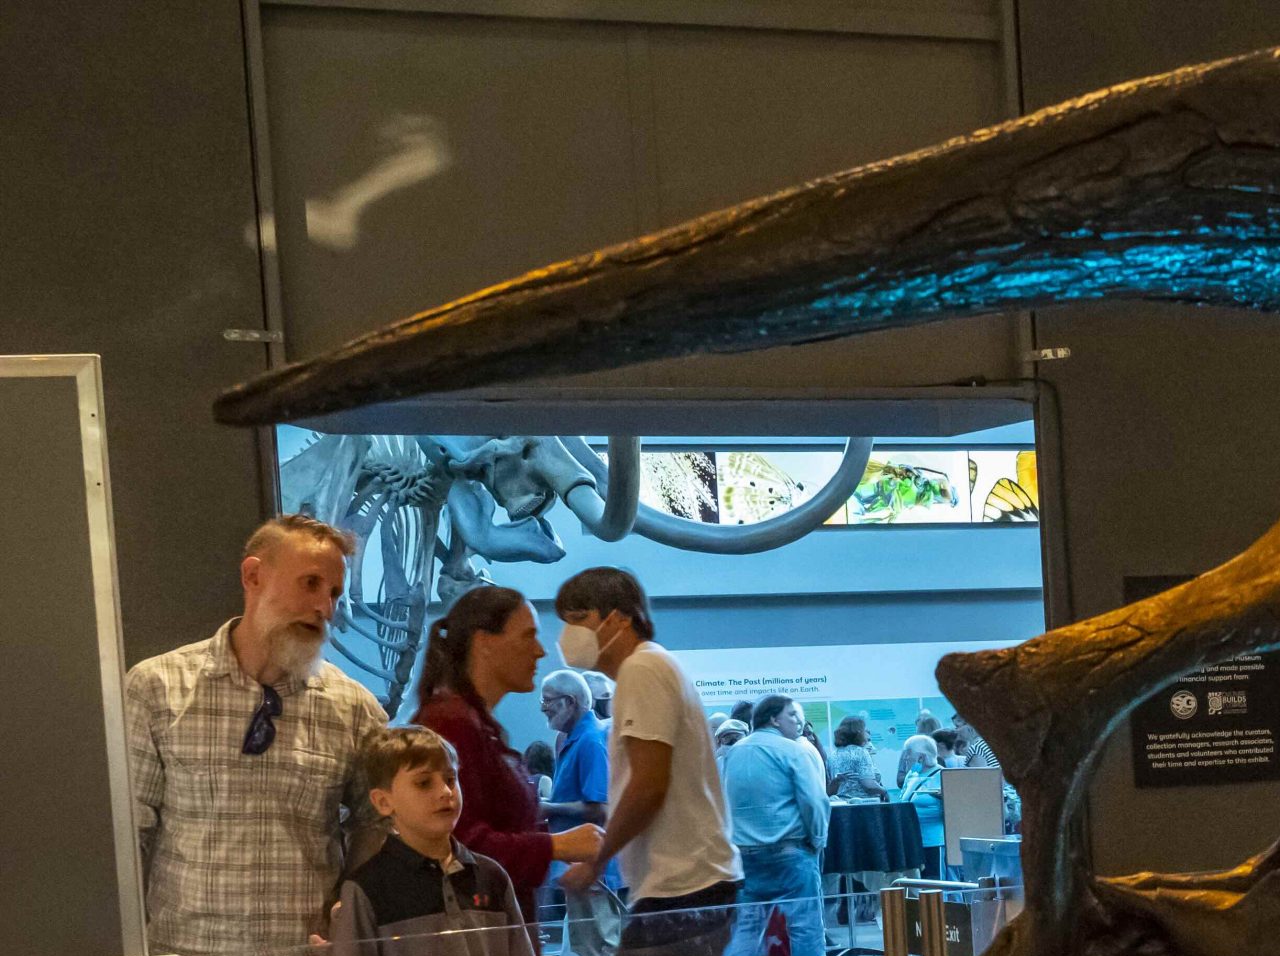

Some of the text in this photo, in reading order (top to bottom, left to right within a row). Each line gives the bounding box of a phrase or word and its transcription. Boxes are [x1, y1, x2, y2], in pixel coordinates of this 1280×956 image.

[1206, 664, 1219, 672] and
[1239, 662, 1265, 672] possible
[743, 678, 761, 686] Past
[762, 677, 794, 686] (millions
[795, 676, 803, 684] of
[804, 675, 827, 685] years)
[1208, 675, 1233, 683] support
[749, 688, 777, 696] impacts
[1222, 696, 1247, 704] BUILDS
[1147, 728, 1272, 742] We gratefully acknowledge the curators,
[1178, 741, 1212, 749] managers,
[1212, 739, 1239, 747] research
[1147, 751, 1175, 759] students
[1176, 750, 1189, 758] and
[1190, 749, 1223, 757] volunteers
[1238, 746, 1274, 755] contributed
[1152, 760, 1166, 768] their
[1183, 759, 1196, 767] and
[1197, 758, 1226, 767] expertise
[1227, 757, 1234, 765] to
[1234, 756, 1247, 764] this
[1247, 755, 1270, 763] exhibit.
[945, 924, 960, 943] Exit
